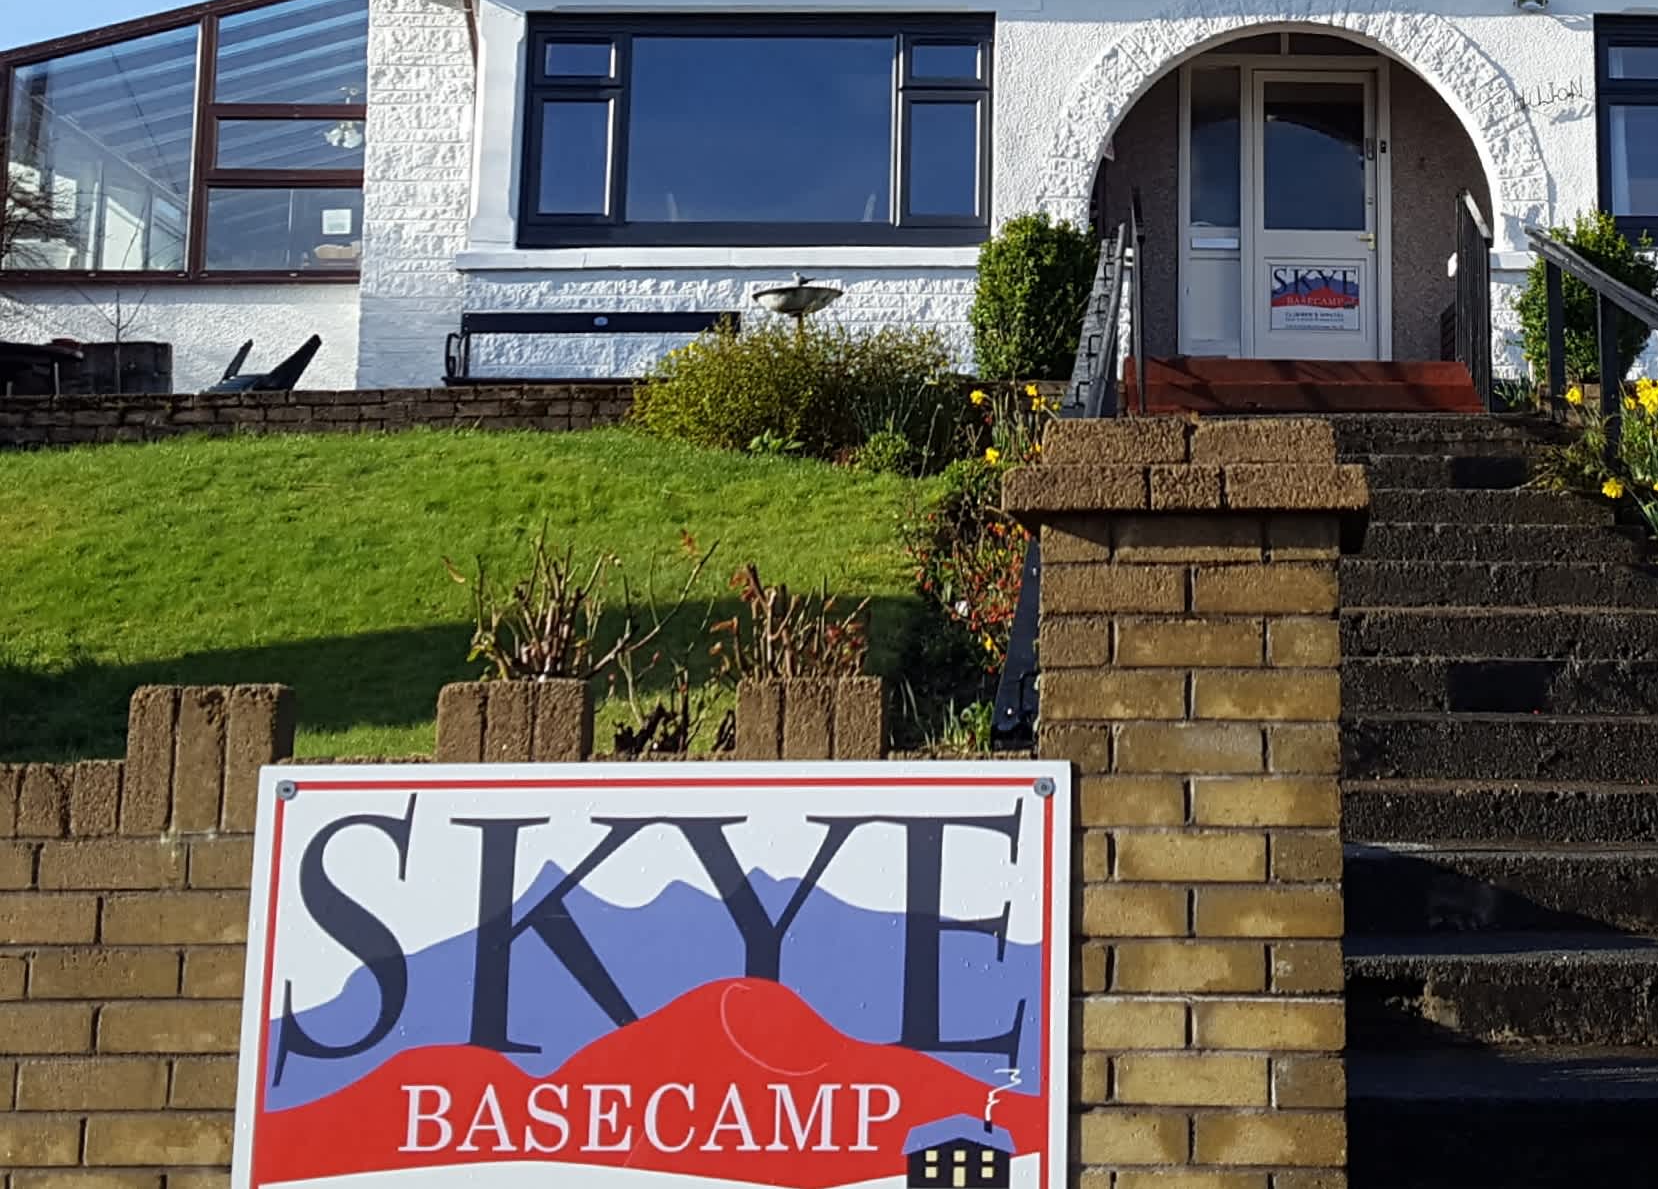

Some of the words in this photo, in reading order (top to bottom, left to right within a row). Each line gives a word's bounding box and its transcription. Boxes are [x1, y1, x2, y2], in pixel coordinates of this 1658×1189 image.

[1271, 268, 1357, 297] SKYE
[1287, 297, 1345, 307] BASECAMP
[272, 792, 1025, 1087] SKYE
[397, 1081, 901, 1152] BASECAMP
